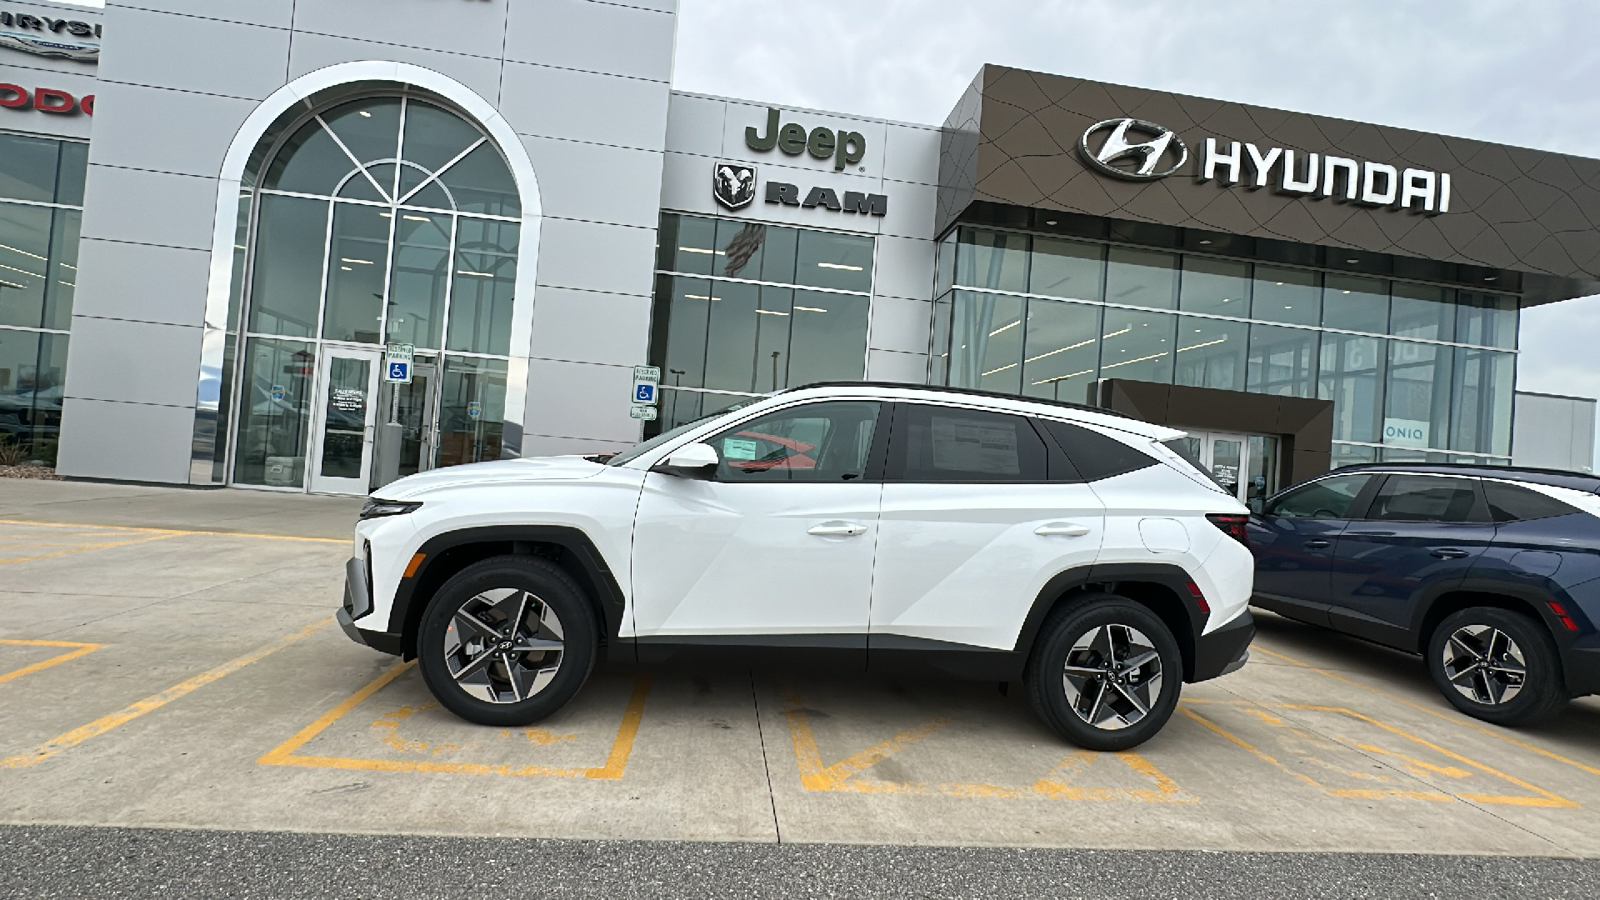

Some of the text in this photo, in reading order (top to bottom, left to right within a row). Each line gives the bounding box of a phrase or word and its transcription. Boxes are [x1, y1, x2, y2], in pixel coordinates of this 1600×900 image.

[745, 107, 866, 171] Jeep
[765, 181, 888, 217] RAM
[1201, 137, 1451, 214] HYUNDAI
[388, 352, 411, 360] PARKING
